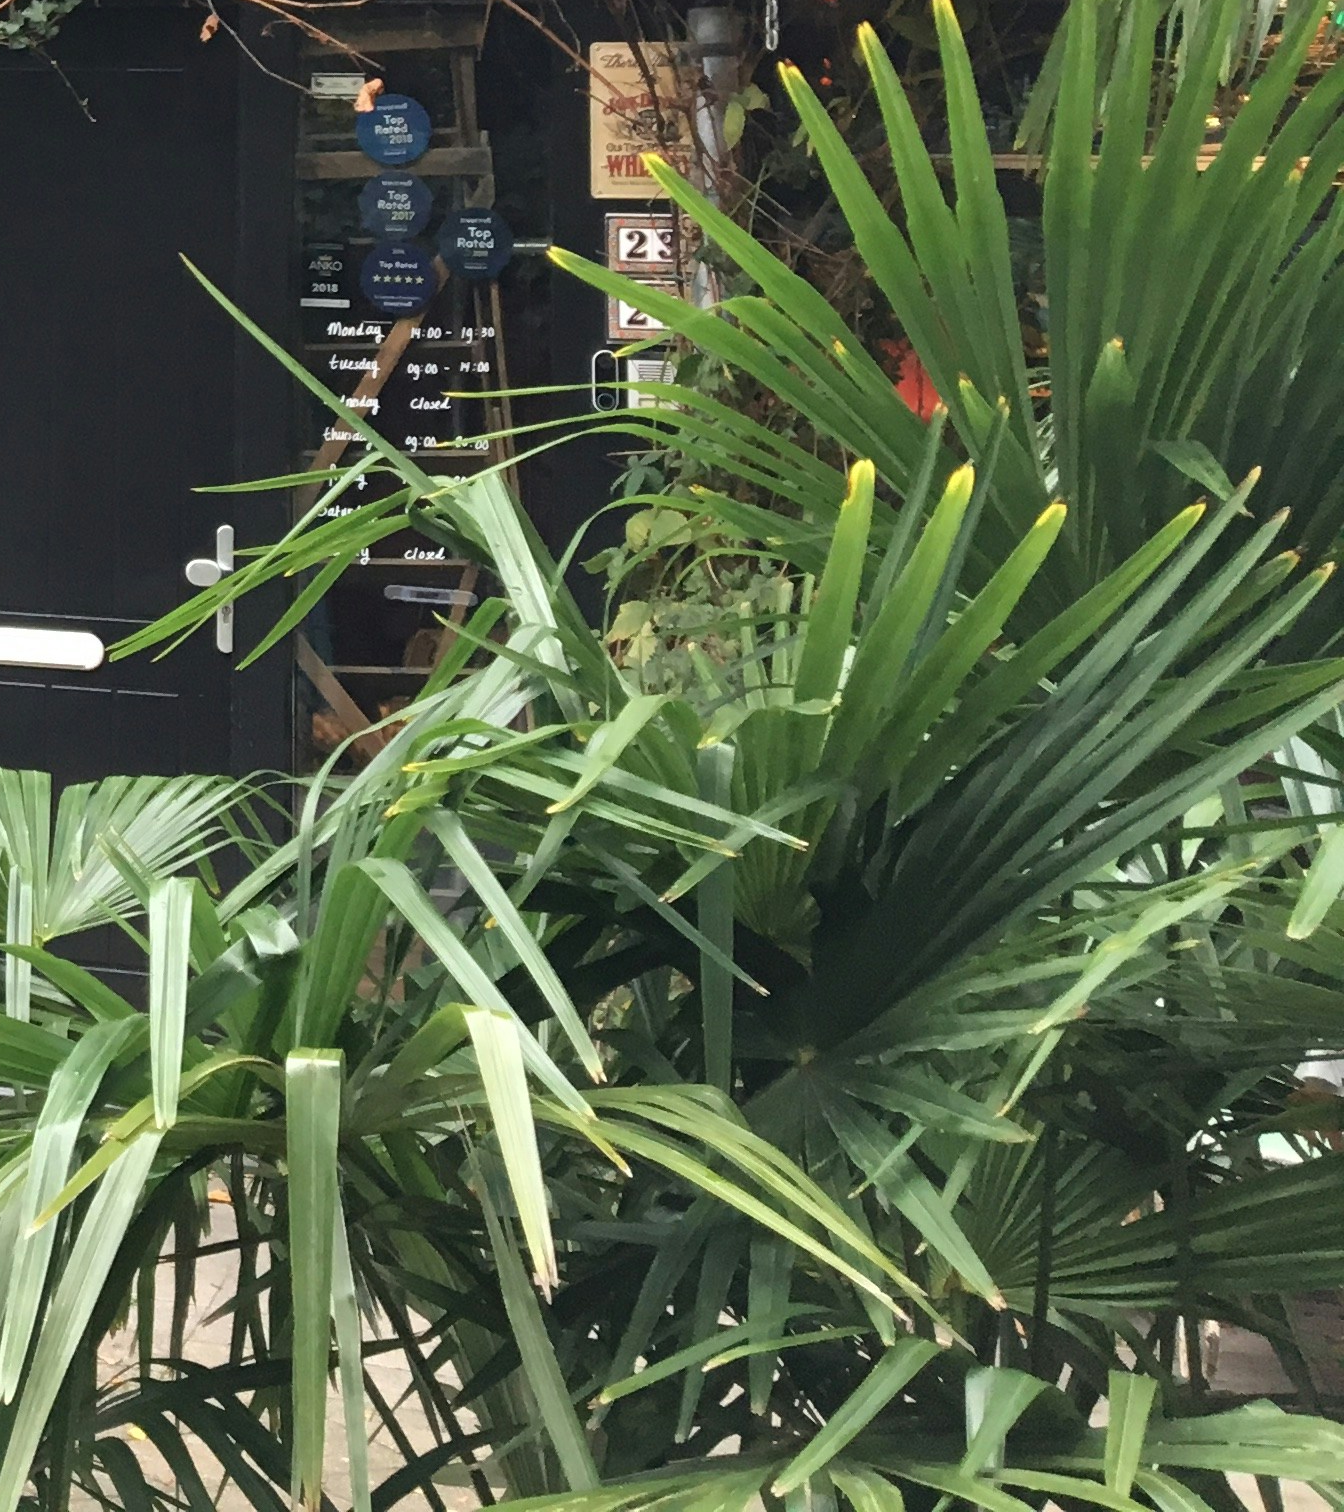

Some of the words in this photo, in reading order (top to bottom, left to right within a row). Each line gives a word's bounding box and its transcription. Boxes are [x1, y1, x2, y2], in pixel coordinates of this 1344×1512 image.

[383, 114, 405, 126] Top
[374, 123, 409, 135] Rated
[387, 190, 409, 202] Top
[377, 199, 411, 210] Rated
[391, 211, 416, 221] 2017
[467, 226, 492, 240] Top
[456, 237, 494, 248] Rated
[379, 261, 393, 270] Top
[395, 261, 418, 270] Rated
[312, 283, 339, 293] 2018
[327, 321, 385, 344] Monday
[410, 326, 442, 339] 14:00
[461, 326, 495, 344] 19:30
[407, 363, 439, 380] 09:00
[460, 361, 490, 373] 14:00
